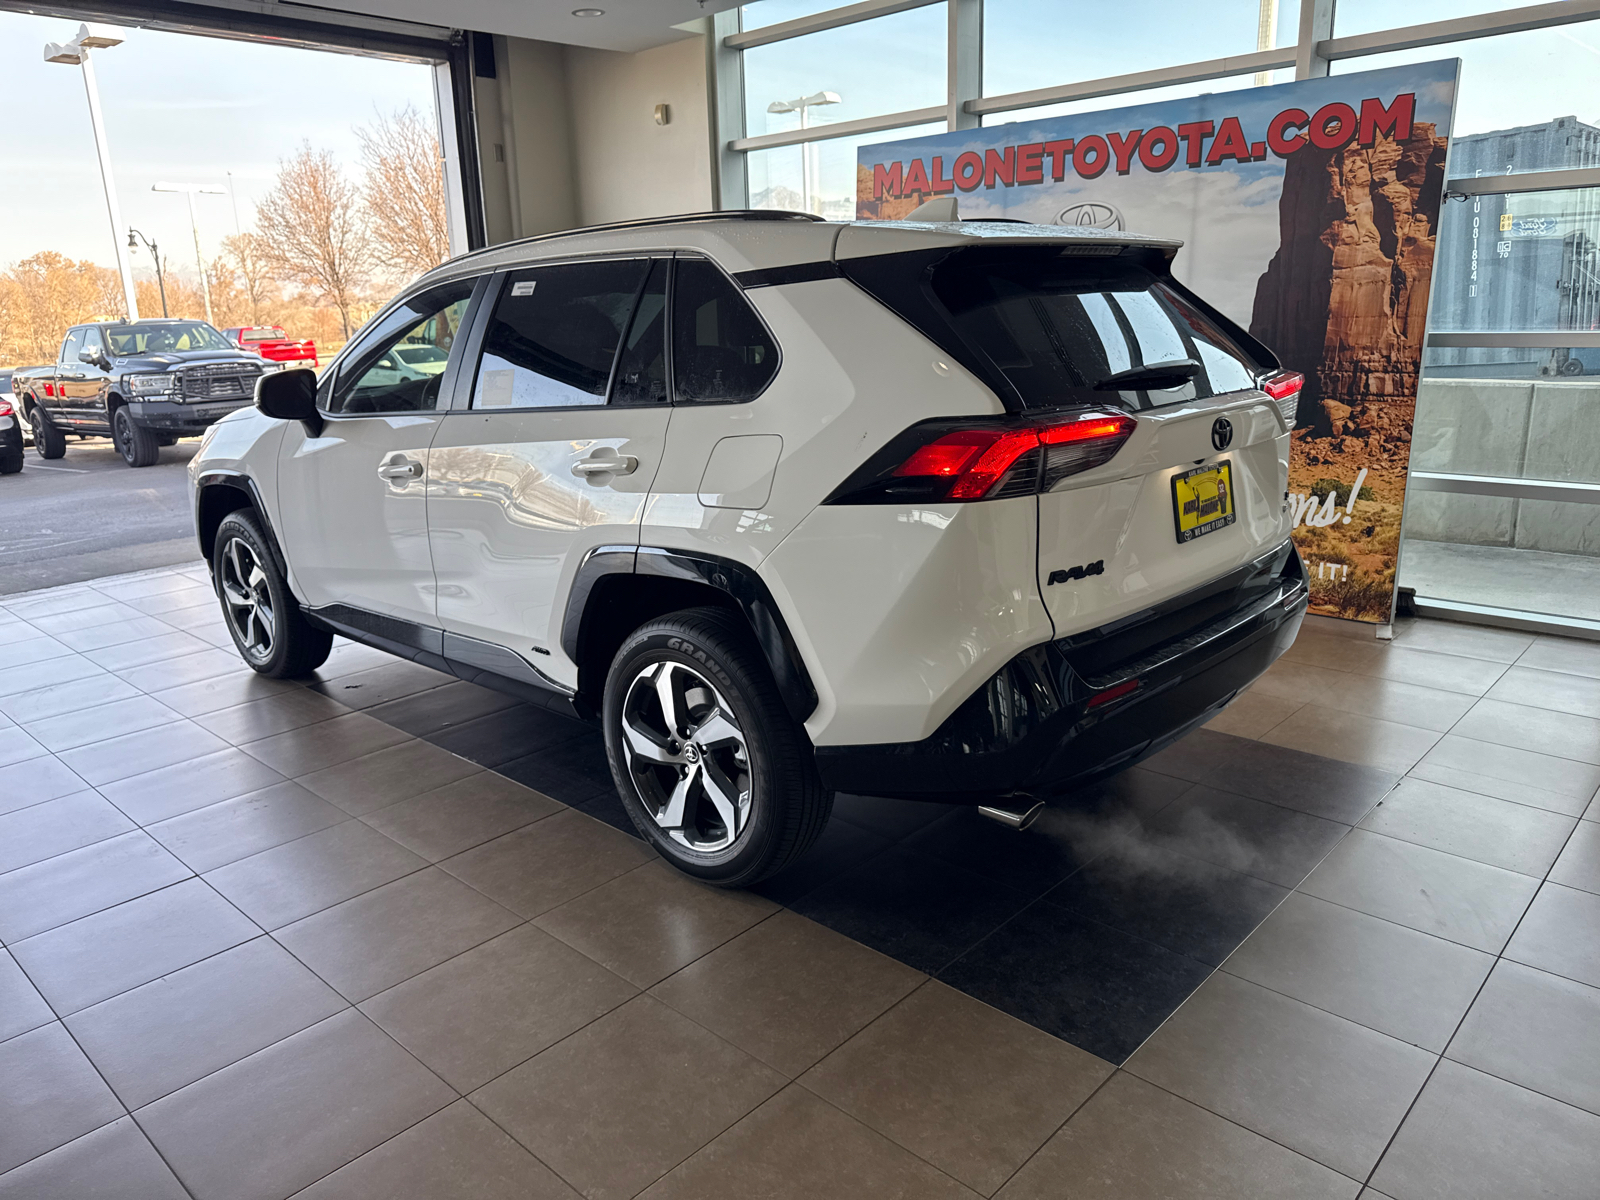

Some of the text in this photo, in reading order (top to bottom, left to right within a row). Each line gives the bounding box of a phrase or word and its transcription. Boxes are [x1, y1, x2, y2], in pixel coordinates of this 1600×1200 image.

[873, 92, 1416, 199] MALONETOYOTA.COM
[1194, 529, 1201, 537] WE
[1201, 523, 1211, 534] MAKE
[1047, 559, 1105, 586] RAV4
[1318, 562, 1348, 582] IT!
